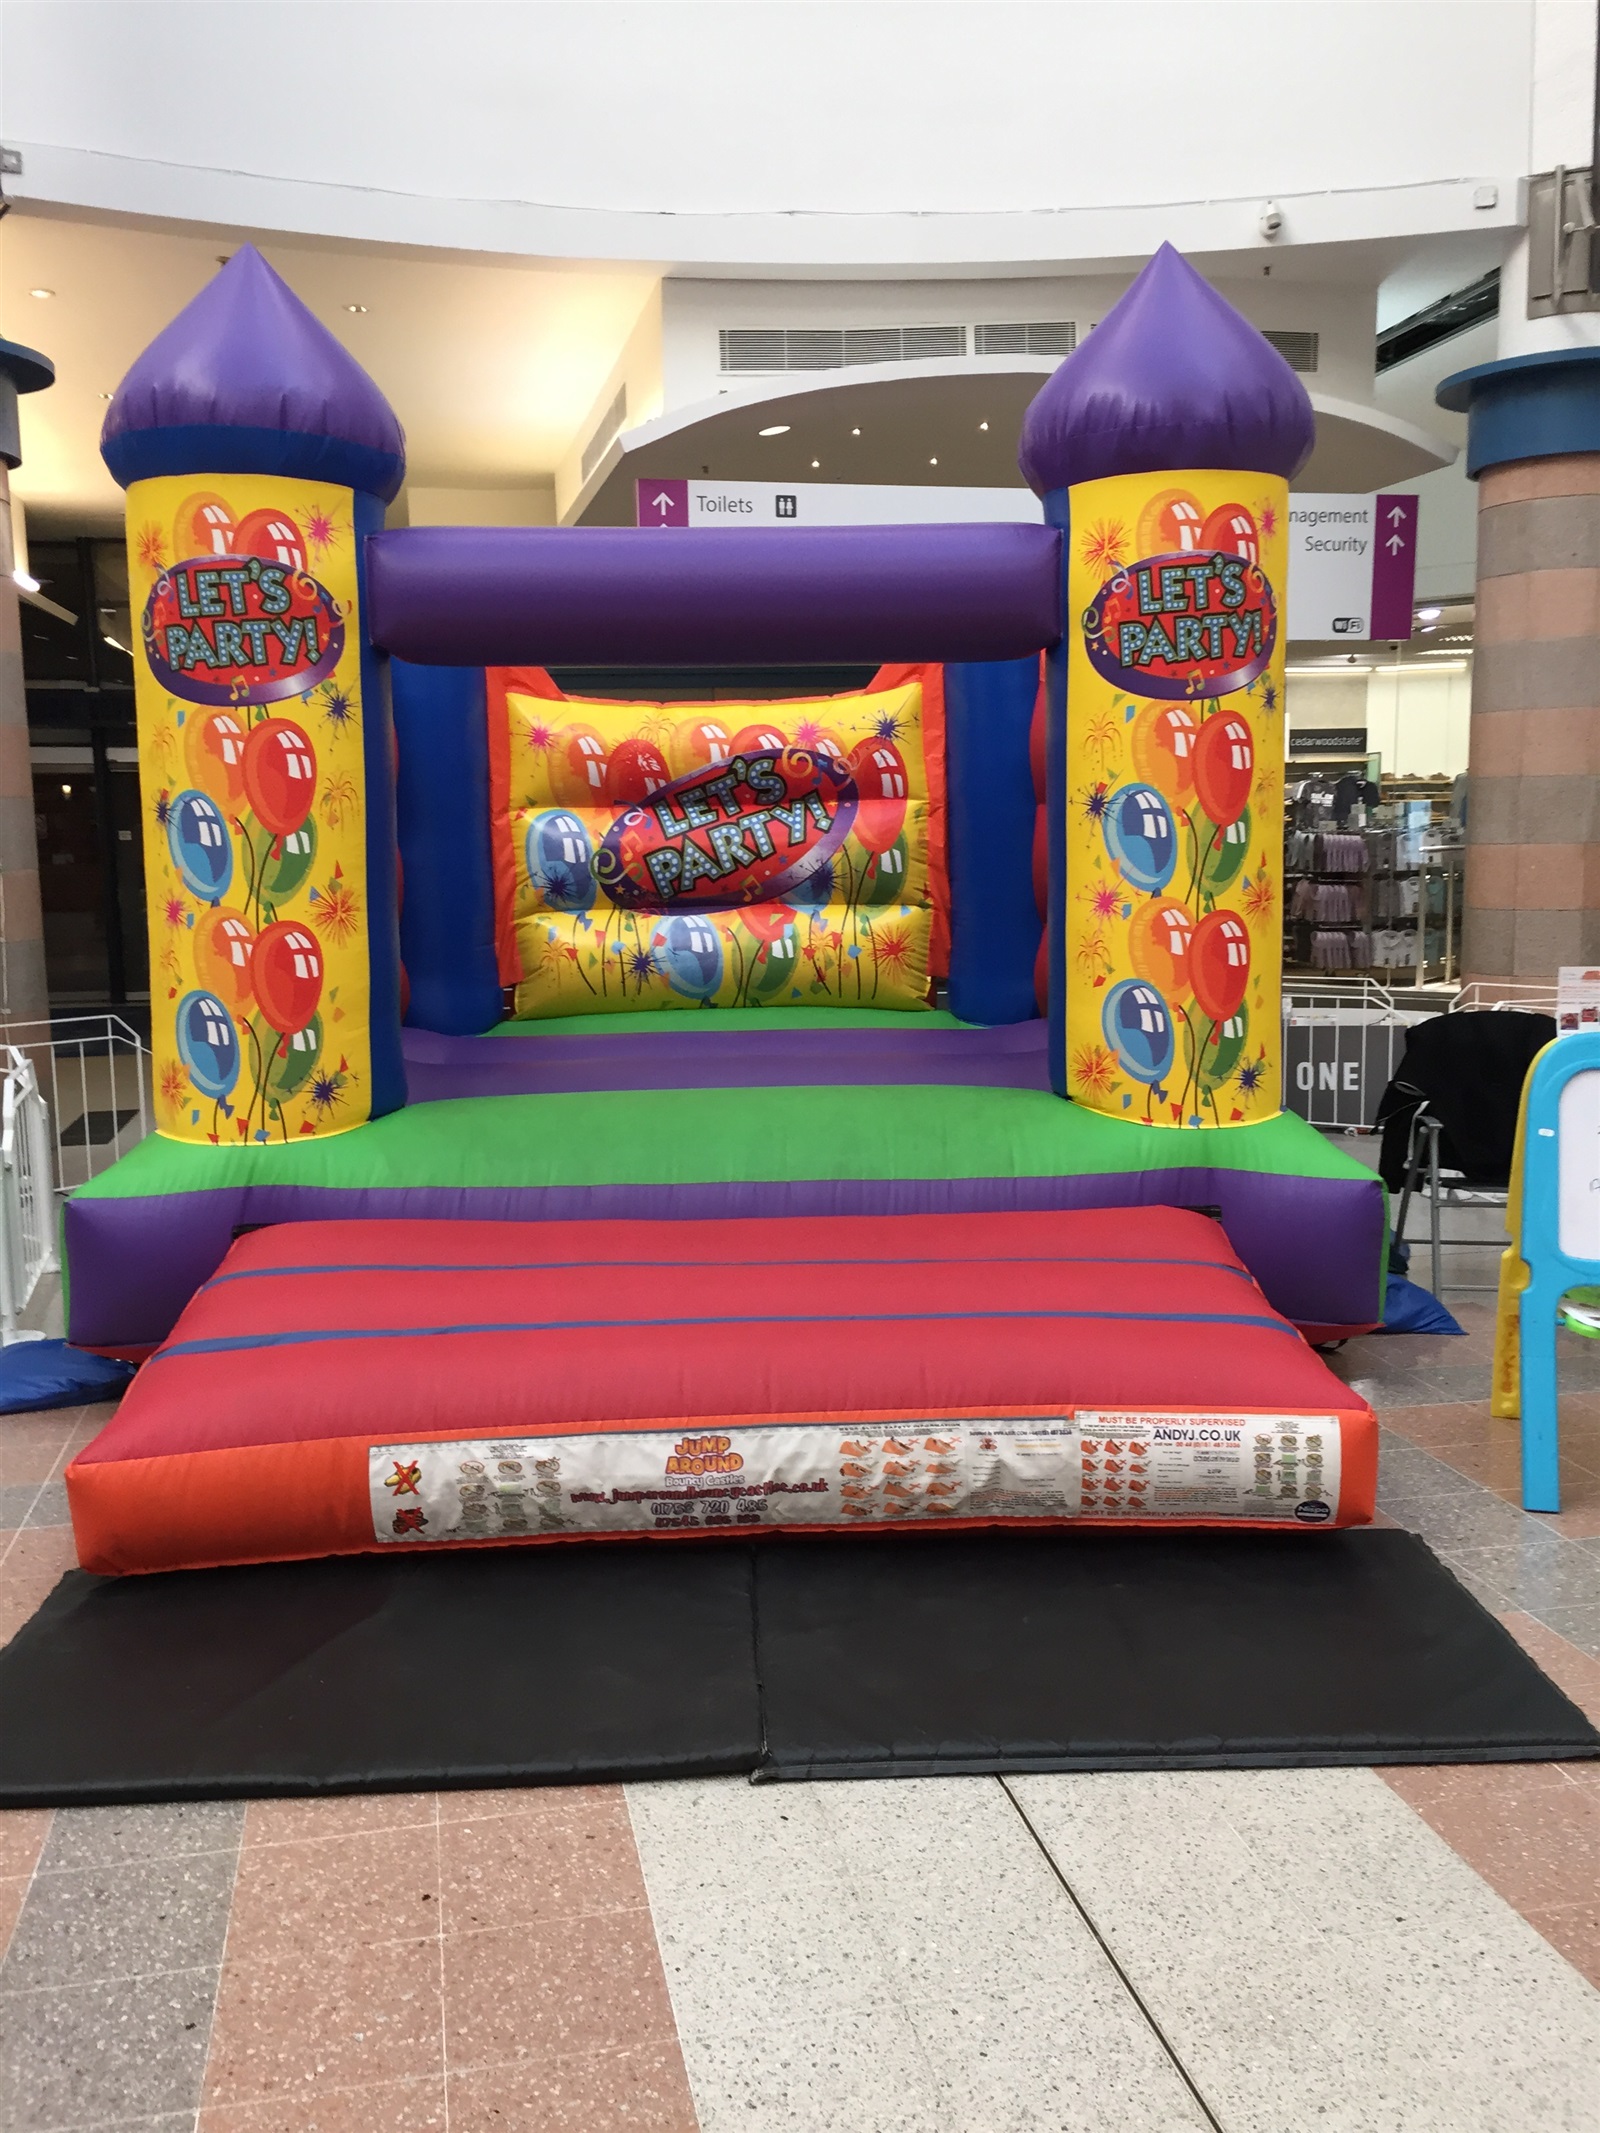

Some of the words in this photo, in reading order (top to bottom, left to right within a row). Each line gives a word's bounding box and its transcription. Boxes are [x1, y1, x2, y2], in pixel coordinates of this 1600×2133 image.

[697, 495, 753, 513] Toilets
[1289, 509, 1369, 527] nagement
[1305, 535, 1367, 555] Security
[175, 557, 291, 620] LET'S
[1136, 554, 1247, 616] LET'S
[165, 616, 321, 671] PARTY!
[1118, 610, 1266, 669] PARTY!
[651, 756, 787, 840] LET'S
[643, 788, 832, 899] PARTY!
[1296, 1062, 1359, 1090] ONE
[1098, 1416, 1124, 1424] MUST
[1126, 1416, 1138, 1424] BE
[1140, 1417, 1187, 1425] PROPERLY
[1189, 1418, 1246, 1427] SUPERVISED
[675, 1435, 731, 1456] JUMP
[1153, 1429, 1242, 1442] ANDYJ.CO.UK
[665, 1453, 743, 1475] AROUND
[665, 1476, 703, 1489] Bouncy
[706, 1474, 745, 1486] Castles
